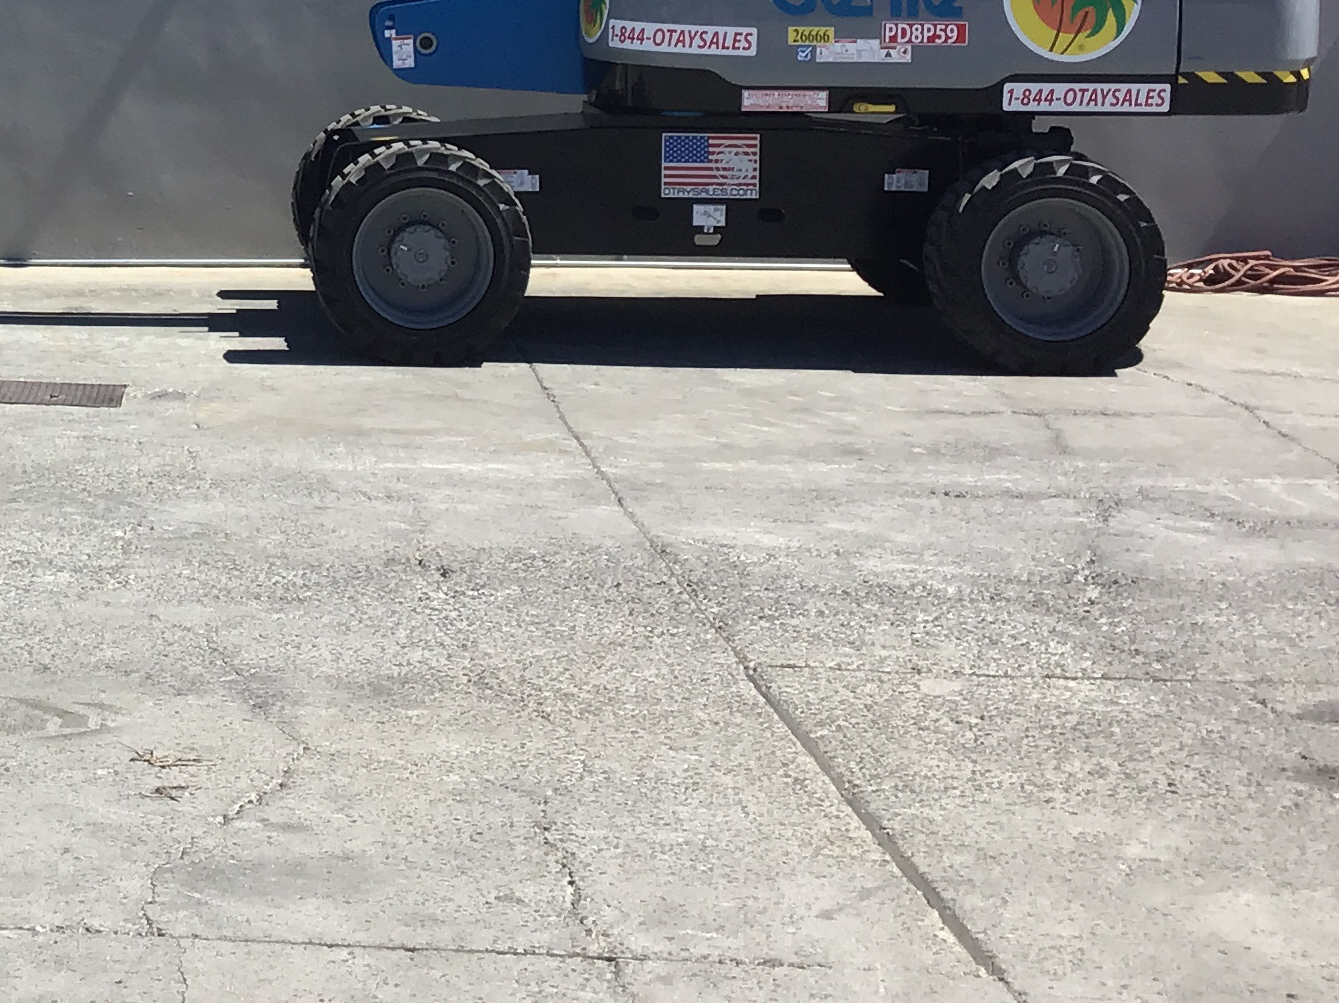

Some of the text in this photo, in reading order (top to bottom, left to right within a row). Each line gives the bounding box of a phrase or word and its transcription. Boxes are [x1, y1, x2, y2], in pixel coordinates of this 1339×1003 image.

[611, 25, 753, 51] 1-844-OTAYSALES
[792, 28, 830, 43] 26666
[885, 23, 958, 43] PD8P59
[1007, 88, 1166, 107] 1-844-OTAYSALES
